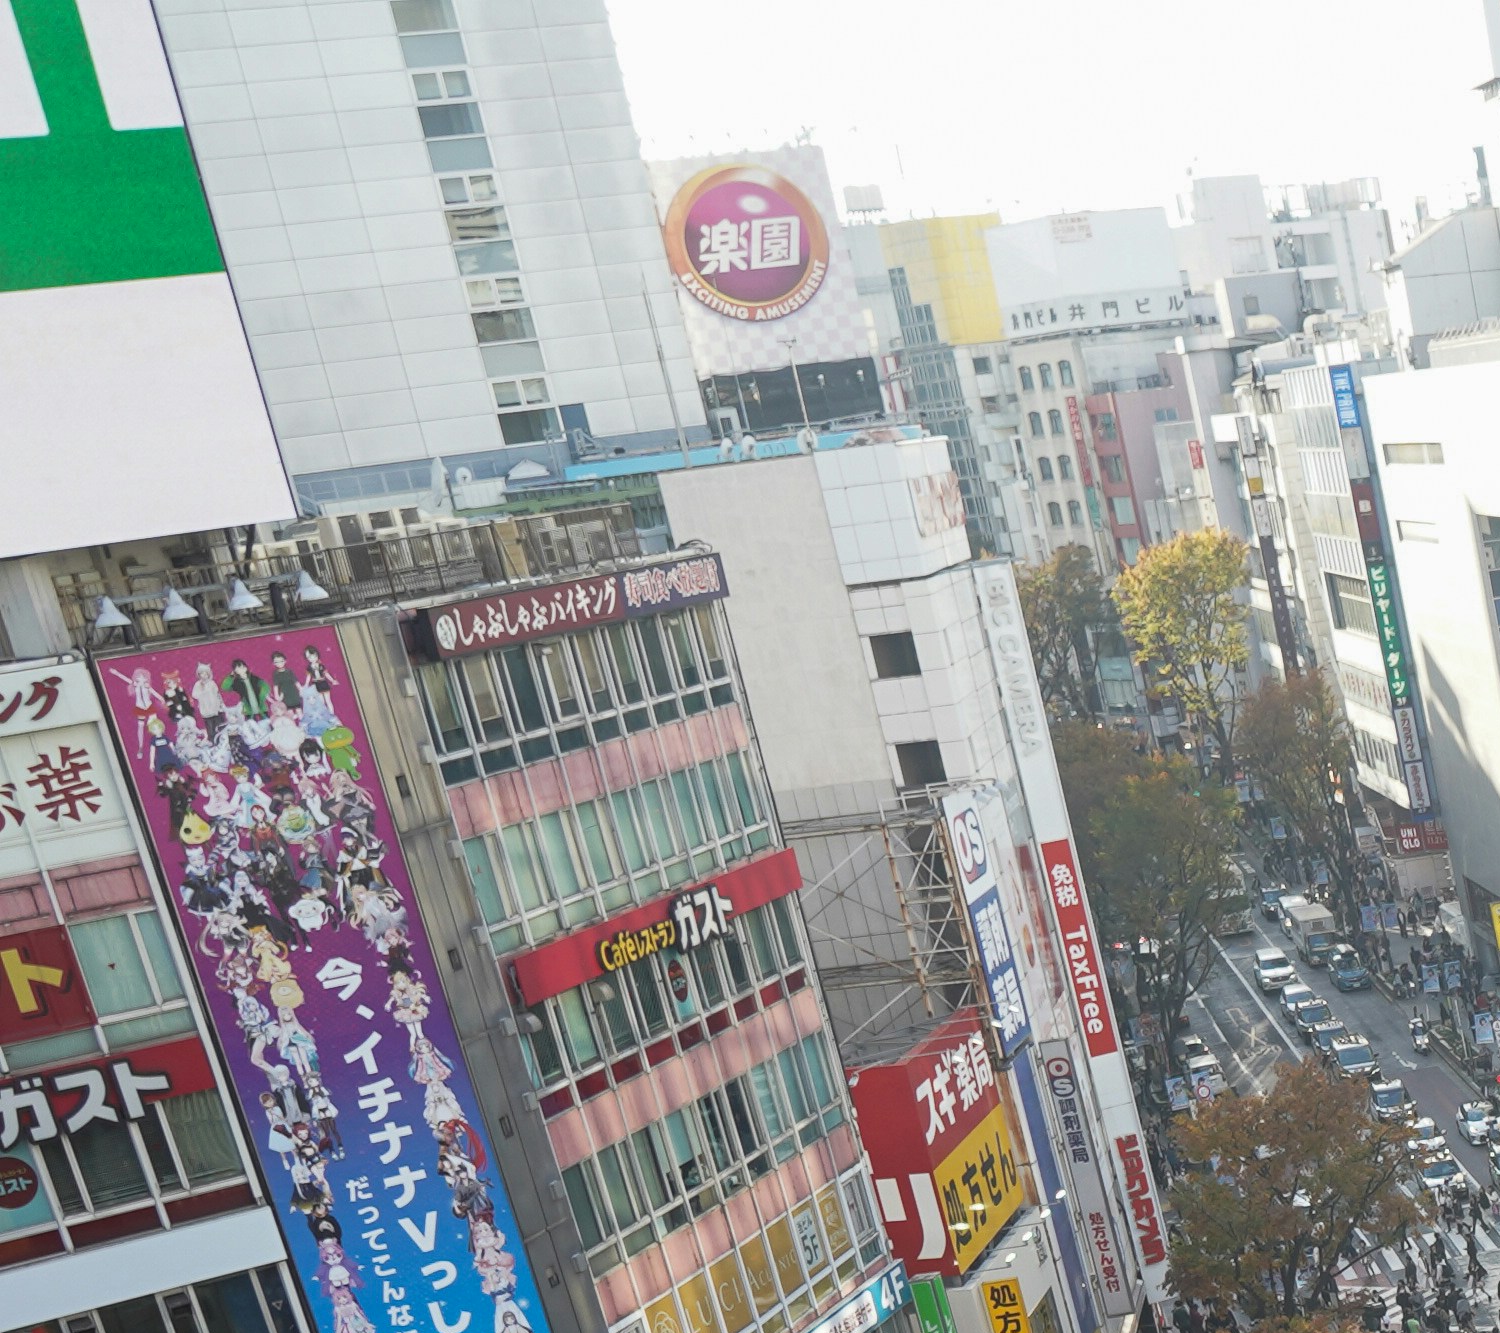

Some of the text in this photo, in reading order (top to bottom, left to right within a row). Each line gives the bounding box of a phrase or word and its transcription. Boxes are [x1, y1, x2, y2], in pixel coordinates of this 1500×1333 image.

[699, 216, 800, 275] 楽園
[681, 260, 827, 321] EXCITING AMUSEMENT
[1068, 296, 1184, 321] 井門ビル
[453, 577, 617, 647] しゃぶしゃぶバイキング
[1371, 566, 1406, 697] ビリヤード・ダーツ
[955, 811, 986, 880] OS
[1400, 827, 1417, 838] UNI
[675, 886, 733, 950] ガスト
[1051, 864, 1080, 907] 免税
[1066, 924, 1103, 1034] TaxFree
[0, 1061, 171, 1149] ガスト
[916, 1030, 994, 1145] スギ薬局
[1047, 1057, 1075, 1098] OS
[942, 1131, 1016, 1254] 処方せん
[1114, 1132, 1166, 1268] ビックカメラ
[801, 1233, 820, 1266] 5F
[1087, 1212, 1121, 1294] 処方せん受付
[881, 1265, 905, 1312] 4F
